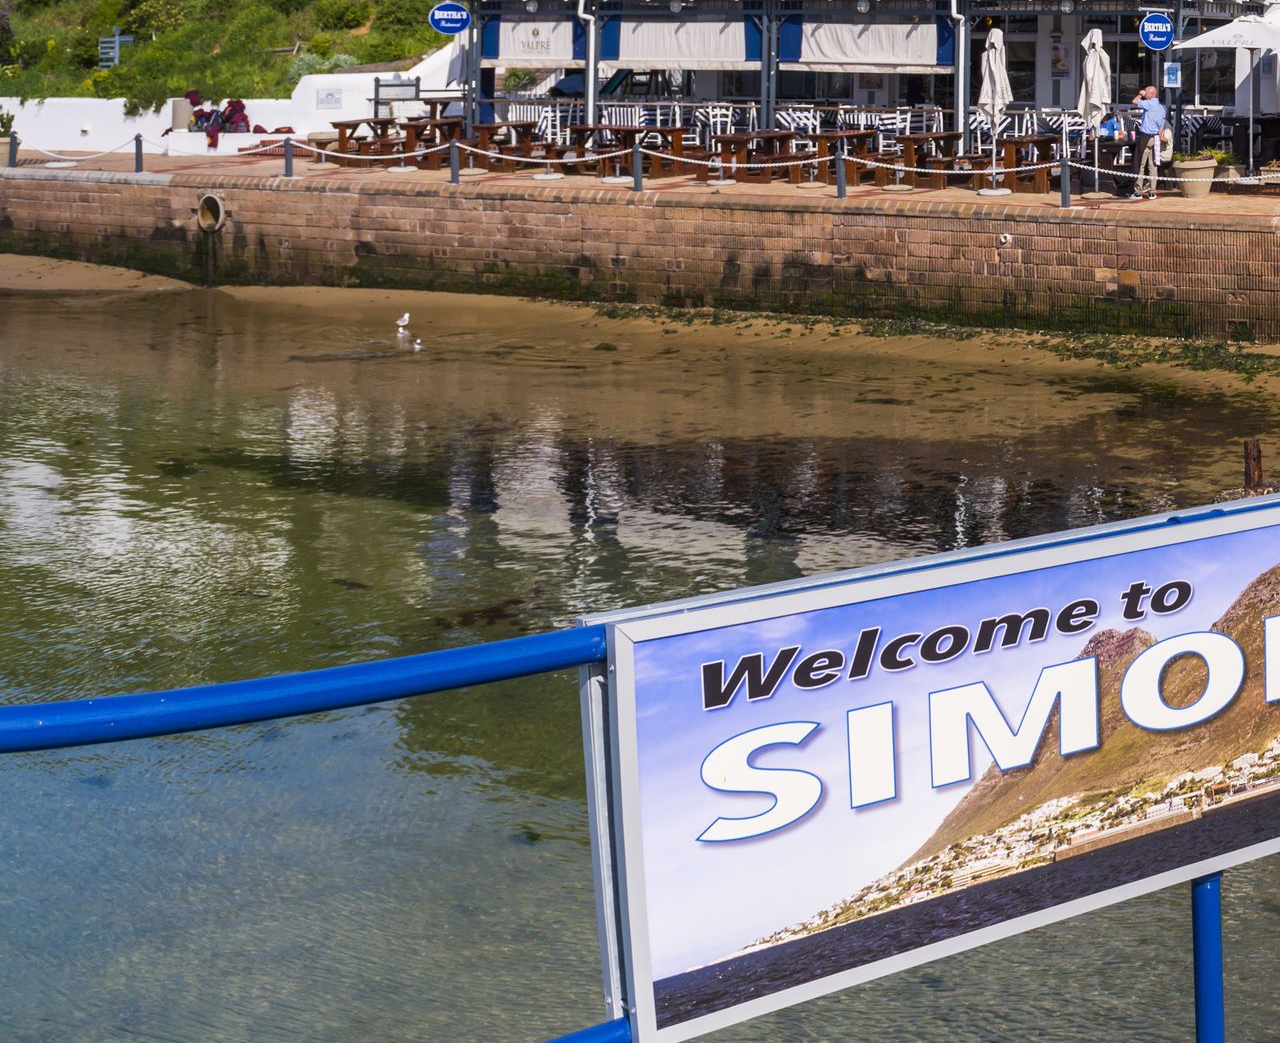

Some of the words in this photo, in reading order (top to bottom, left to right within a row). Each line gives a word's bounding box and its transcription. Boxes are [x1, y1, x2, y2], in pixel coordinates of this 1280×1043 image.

[434, 10, 468, 20] BERTHA'S
[1144, 22, 1171, 32] BERTHA'S
[700, 597, 1100, 710] Welcome
[1121, 579, 1194, 621] to
